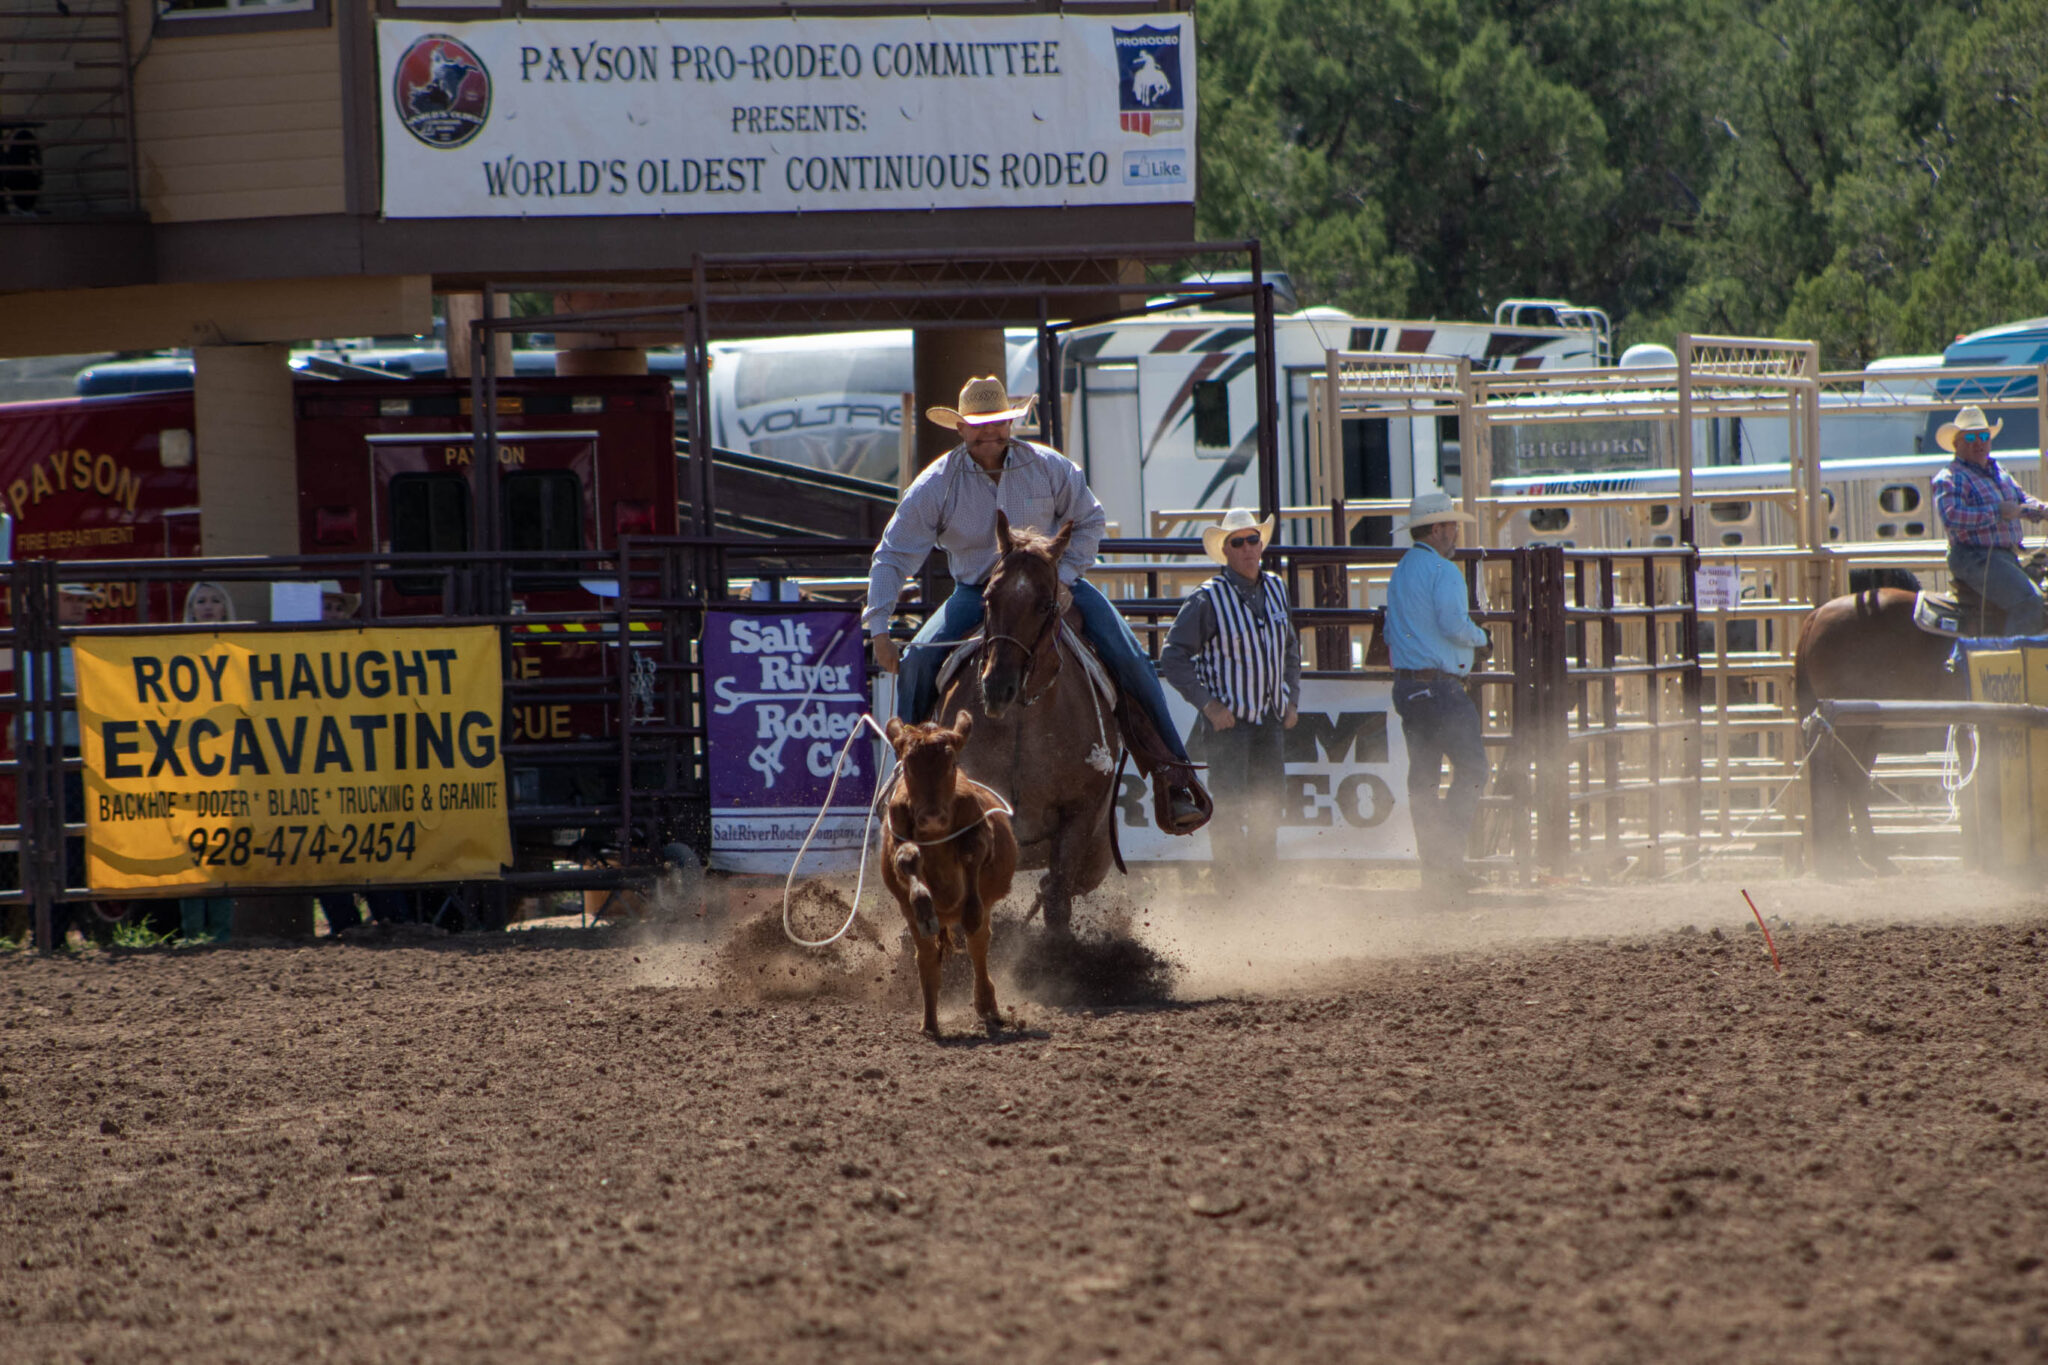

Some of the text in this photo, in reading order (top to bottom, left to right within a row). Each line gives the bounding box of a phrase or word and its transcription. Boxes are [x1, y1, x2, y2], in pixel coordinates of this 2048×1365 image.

[1115, 35, 1178, 46] PRORODEO
[521, 41, 1060, 83] PAYSON PRO-RODEO COMMITTEE
[732, 104, 867, 133] PRESENTS:
[483, 151, 1108, 197] WORLD'S OLDEST CONTINUOUS RODEO
[1152, 160, 1182, 177] Like
[1519, 437, 1647, 459] BIGHORN
[8, 449, 141, 520] PAYSON
[1545, 480, 1600, 494] WILSON
[17, 526, 135, 552] FIRE DEPARTMENT
[730, 618, 813, 654] Salt
[133, 654, 229, 703] ROY
[248, 649, 457, 701] HAUGHT
[759, 652, 852, 692] River
[755, 702, 866, 739] Rodeo
[102, 711, 496, 779] EXCAVATING
[806, 742, 861, 778] Co.
[99, 782, 498, 822] BACKHOE DOZER BLADE TRUCKING & GRANITE
[188, 821, 416, 868] 928-474-2454
